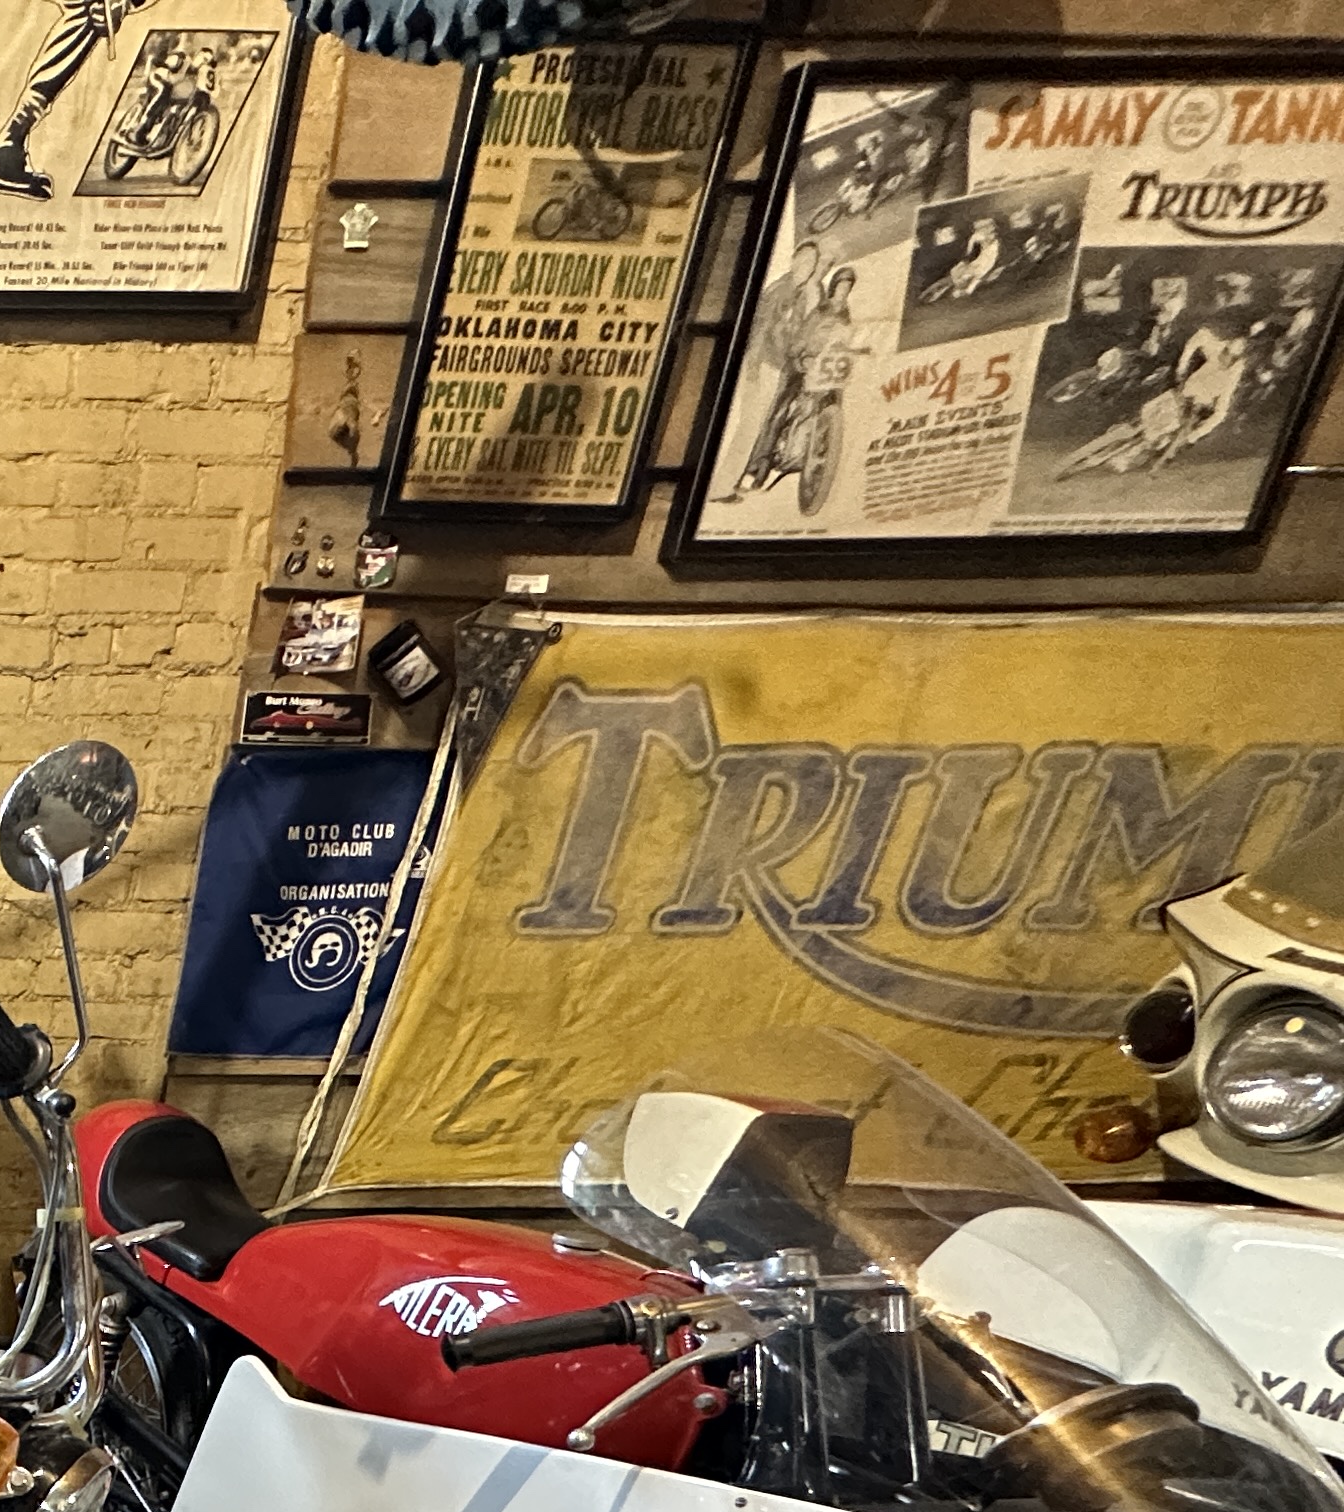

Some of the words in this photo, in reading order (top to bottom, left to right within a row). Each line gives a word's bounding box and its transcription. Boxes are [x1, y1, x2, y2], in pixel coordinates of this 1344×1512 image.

[985, 88, 1169, 150] SAMMY
[1120, 169, 1329, 222] TRIUMPH
[4, 276, 33, 286] Fastest
[36, 276, 48, 286] 20
[446, 249, 508, 295] EVERY
[510, 251, 613, 298] SATURDAY
[613, 255, 677, 300] NIGHT
[474, 300, 509, 312] FIRST
[437, 317, 579, 342] OKLAHOMA
[599, 320, 659, 344] CITY
[431, 343, 552, 375] FAIRGROUNDS
[560, 348, 652, 378] SPEEDWAY
[880, 360, 941, 403] WINS
[928, 359, 961, 405] 4
[977, 353, 1012, 401] 5
[421, 380, 507, 409] OPENING
[508, 383, 585, 436] APR.
[596, 386, 640, 437] 10
[428, 412, 486, 433] NITE
[423, 436, 475, 472] EVERY
[580, 441, 624, 476] SEPT.
[288, 825, 340, 841] MOTO
[352, 824, 395, 839] CLUB
[307, 841, 373, 858] D'AGADIR
[280, 882, 390, 901] ORGANISATION
